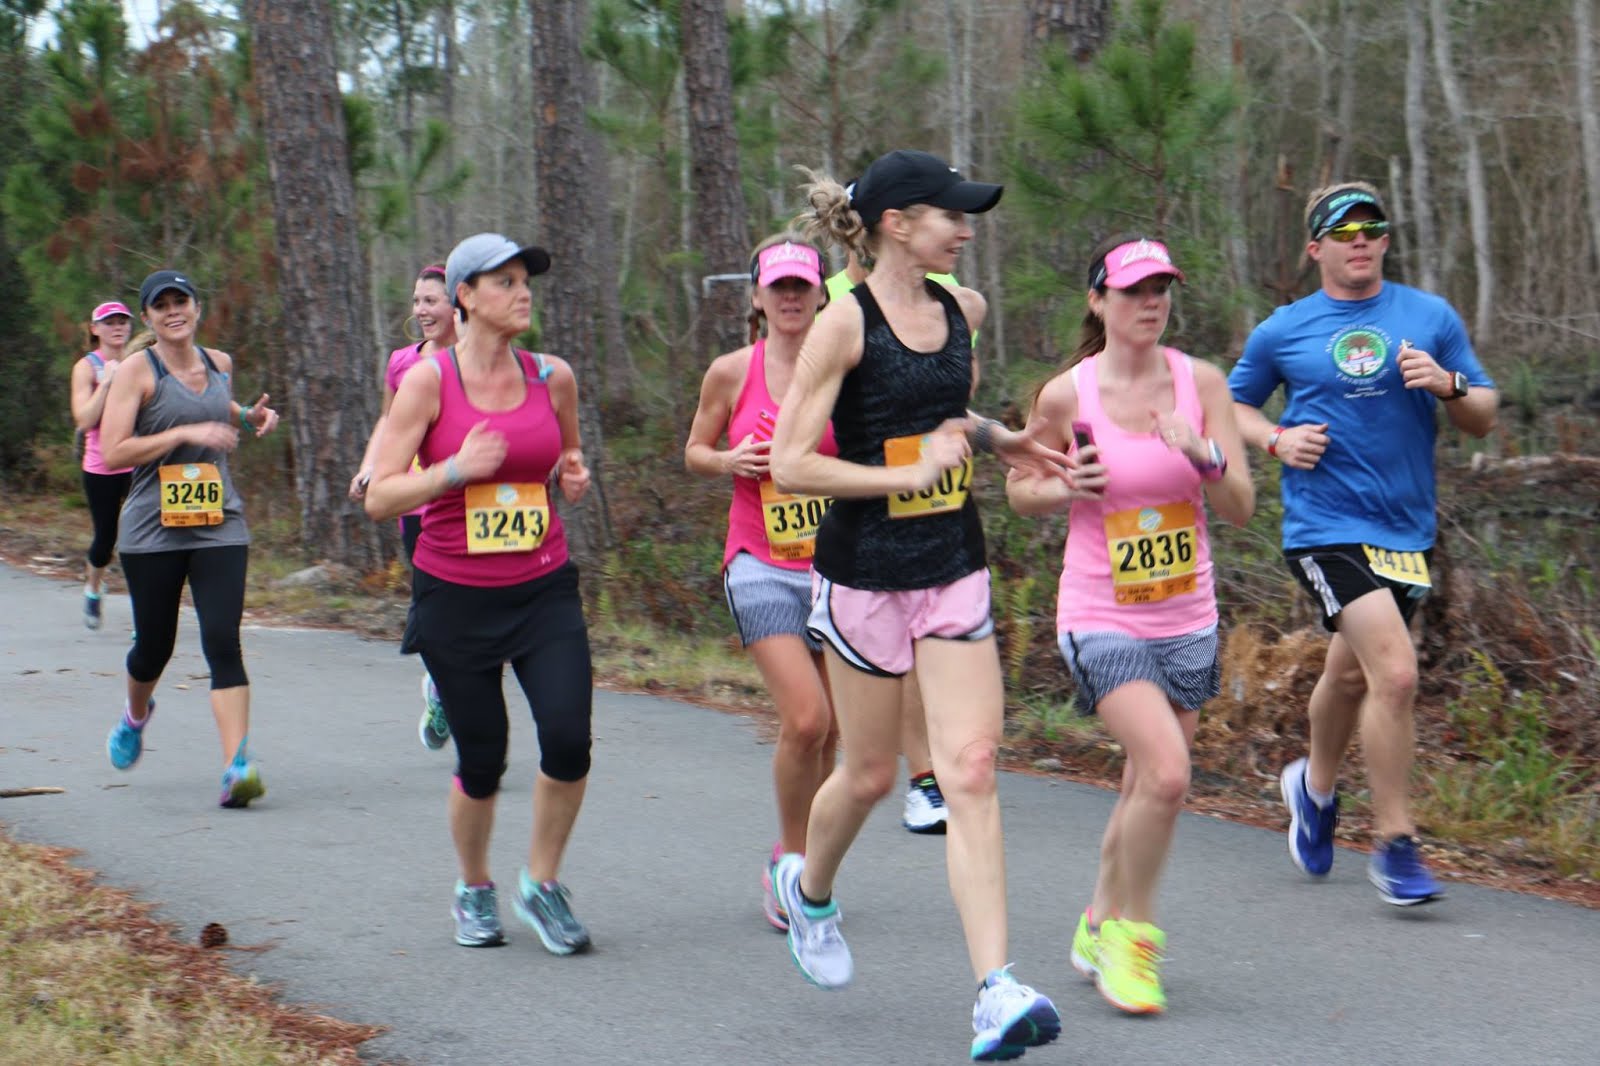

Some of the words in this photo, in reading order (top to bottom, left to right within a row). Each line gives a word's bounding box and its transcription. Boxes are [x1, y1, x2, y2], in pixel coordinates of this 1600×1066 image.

[167, 482, 218, 504] 3246
[474, 510, 544, 539] 3243
[771, 498, 834, 533] 330
[1117, 531, 1191, 572] 2836
